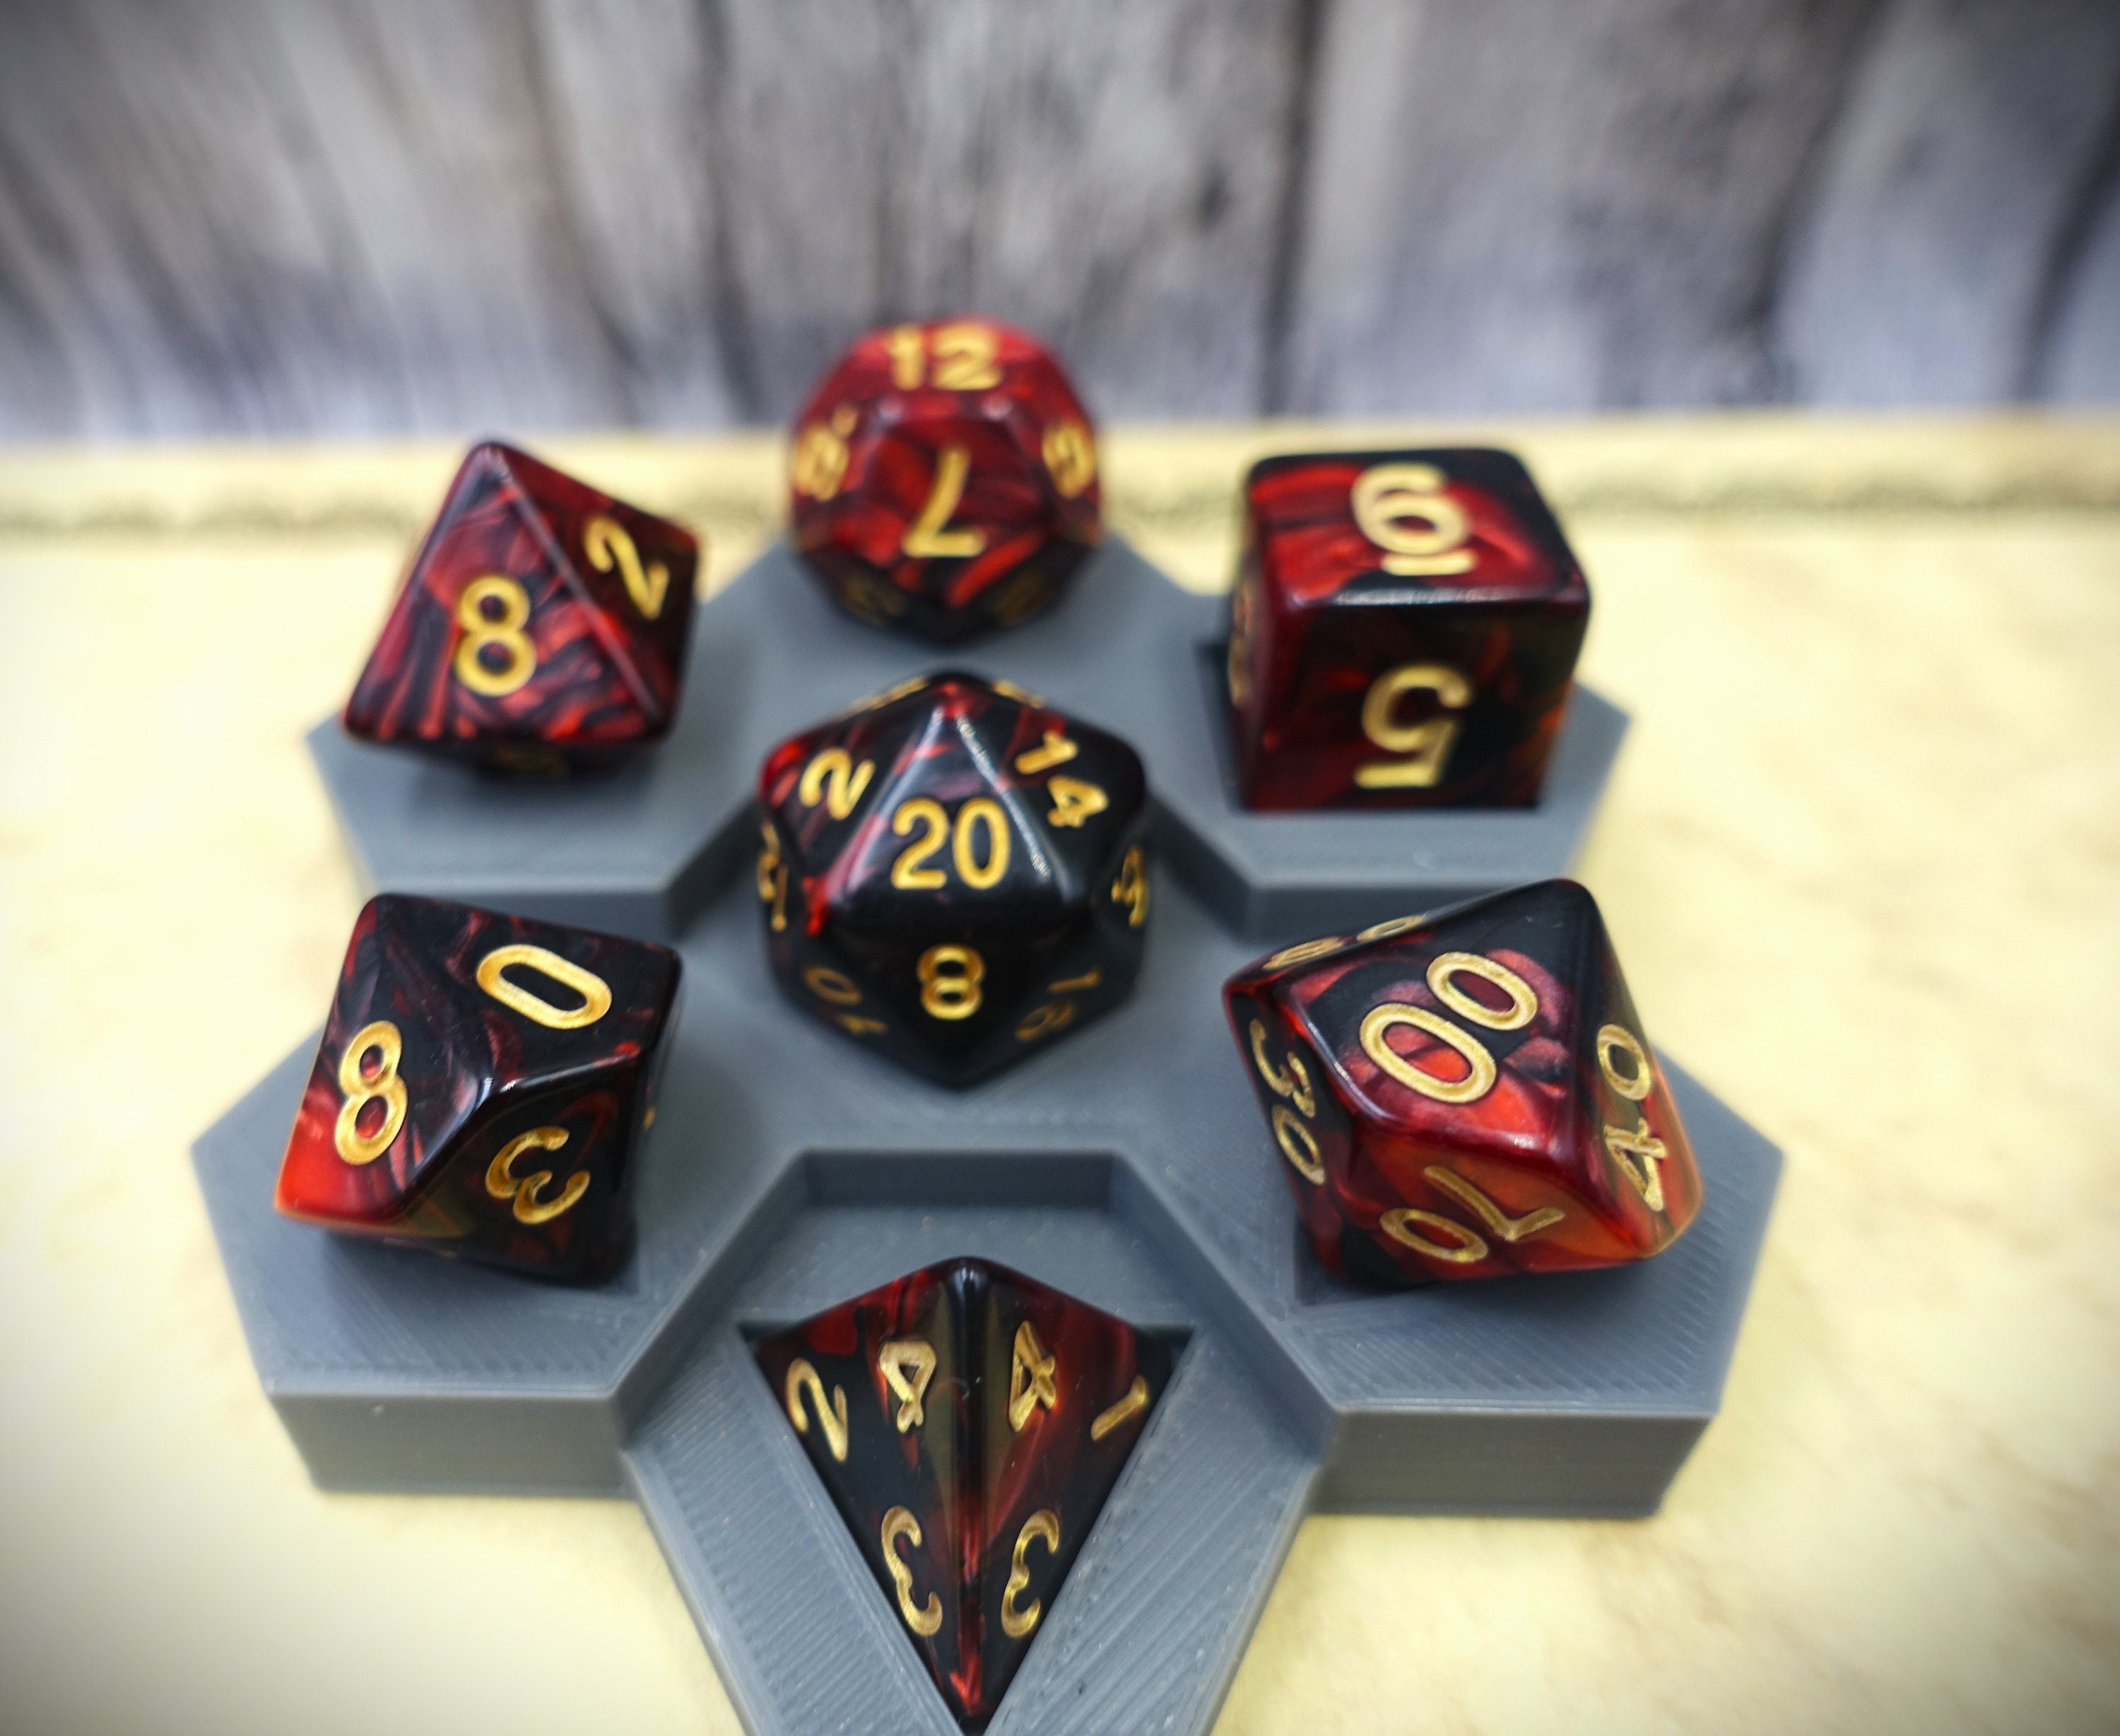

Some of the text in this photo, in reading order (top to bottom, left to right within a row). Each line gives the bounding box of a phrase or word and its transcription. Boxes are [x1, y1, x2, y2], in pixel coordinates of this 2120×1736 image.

[889, 322, 1003, 391] 12
[902, 444, 987, 558] 7
[583, 515, 671, 620] 2
[453, 573, 538, 697] 8
[1355, 662, 1471, 789] 5
[799, 747, 876, 820] 2
[1015, 731, 1109, 828] 14
[890, 796, 1011, 890] 20
[476, 944, 611, 1029] 0
[917, 943, 985, 1021] 8
[1360, 952, 1537, 1103] 00
[334, 1020, 408, 1165] 8
[1249, 1019, 1325, 1185] 30
[1596, 1023, 1666, 1210] 40
[485, 1126, 591, 1224] 3
[1379, 1167, 1564, 1263] 70
[786, 1357, 848, 1462] 2
[879, 1341, 937, 1434] 4
[1008, 1320, 1056, 1432] 4
[1090, 1374, 1150, 1441] 1
[881, 1505, 943, 1637] 3
[1001, 1508, 1059, 1638] 3
